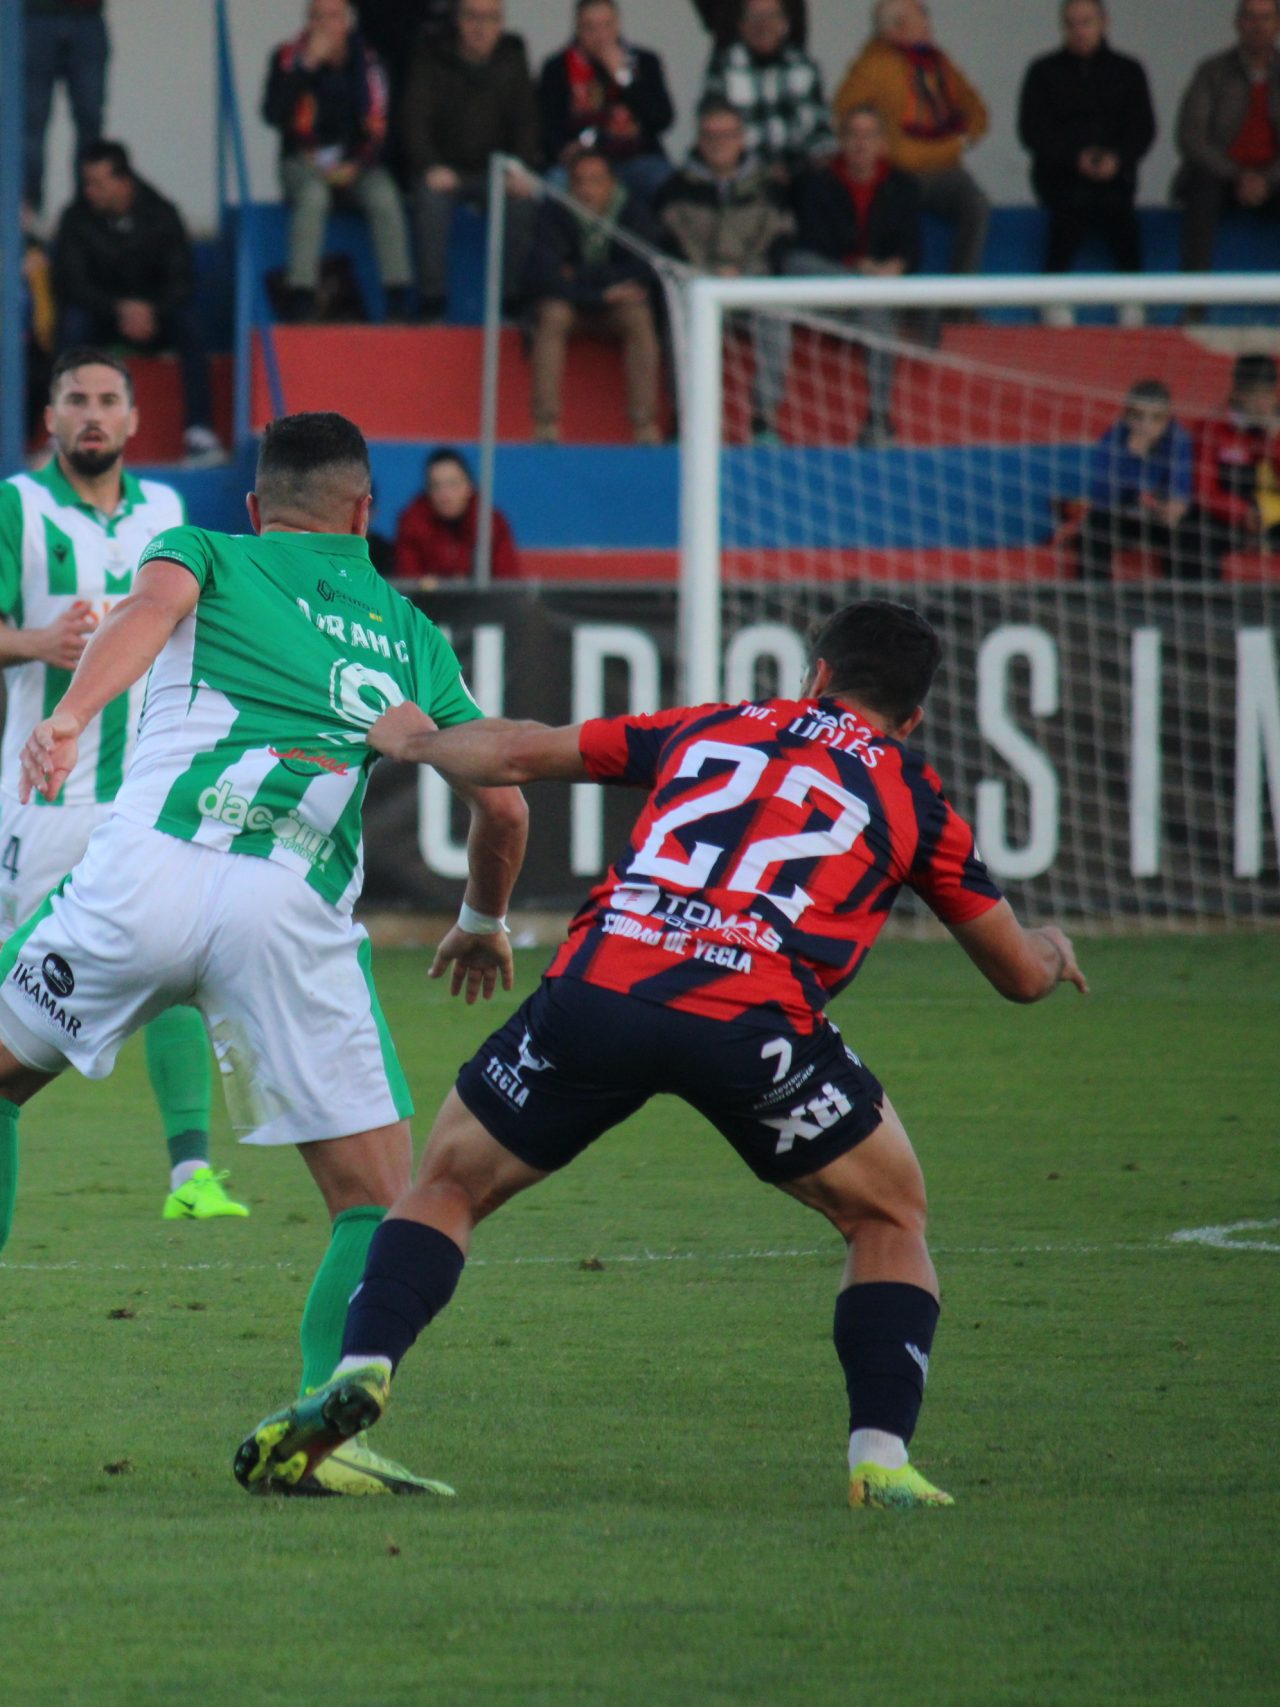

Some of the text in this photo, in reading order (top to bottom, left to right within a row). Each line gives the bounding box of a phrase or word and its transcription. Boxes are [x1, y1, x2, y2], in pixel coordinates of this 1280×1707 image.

[1, 835, 21, 882] 4
[626, 740, 871, 926] 22
[663, 893, 783, 953] TOMÁS
[692, 937, 753, 975] YECLA
[760, 1082, 852, 1155] Xti
